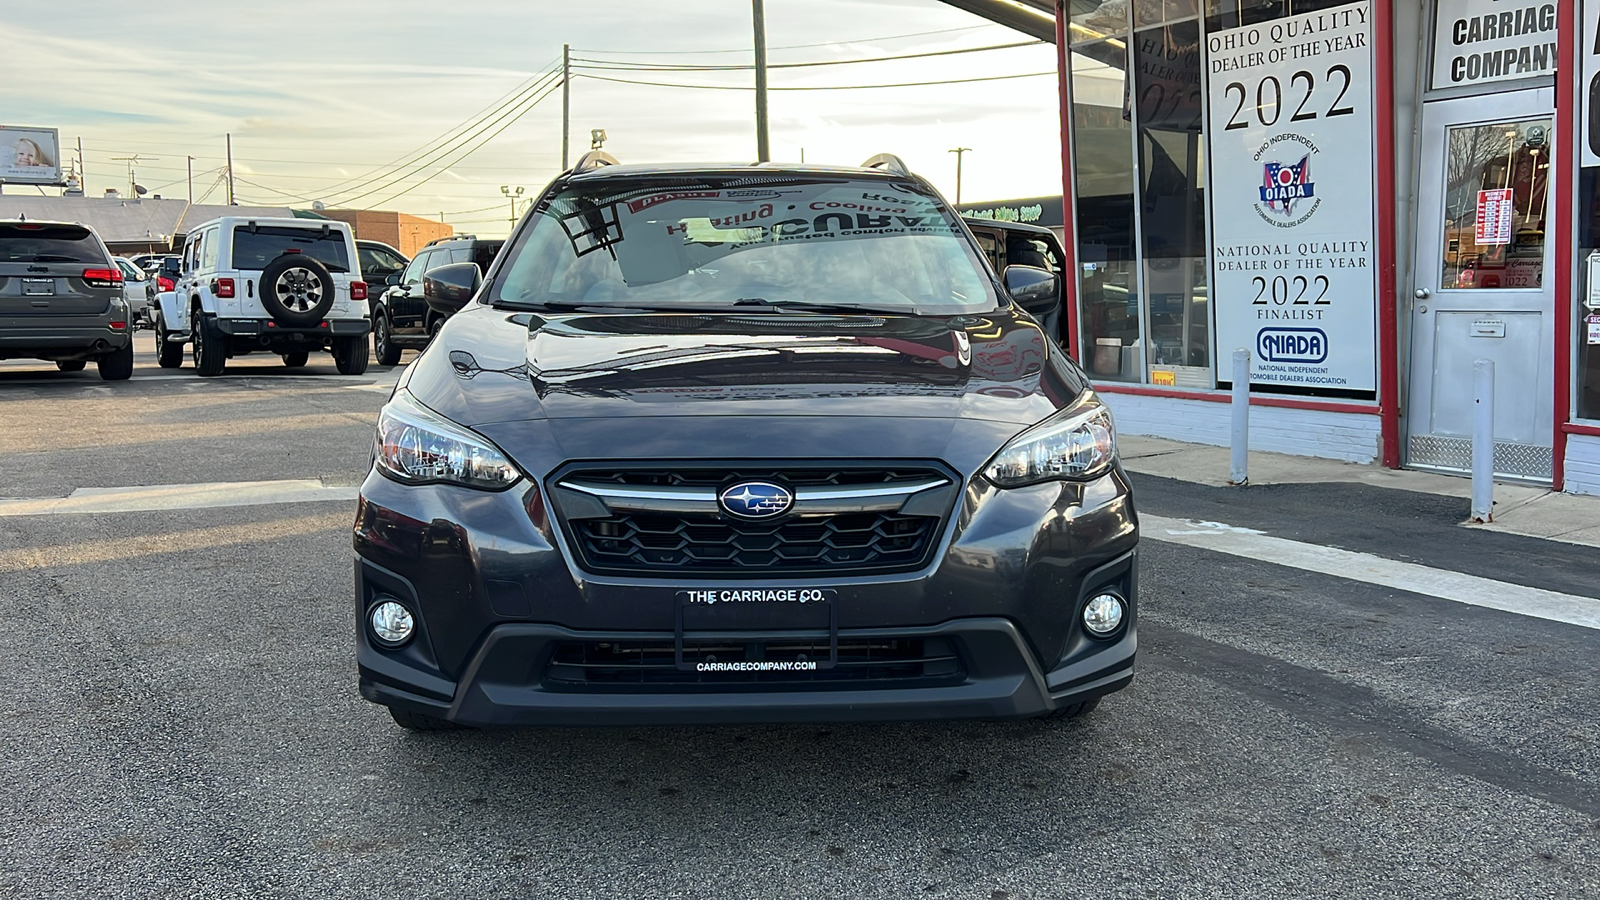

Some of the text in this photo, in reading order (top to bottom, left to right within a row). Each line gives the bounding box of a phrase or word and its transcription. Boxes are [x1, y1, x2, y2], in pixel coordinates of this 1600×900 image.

[1209, 6, 1369, 53] OHIO QUALITY
[1452, 4, 1559, 46] CARRIAG
[1212, 52, 1265, 73] DEALER
[1268, 47, 1287, 63] OF
[1290, 41, 1321, 59] THE
[1324, 32, 1366, 53] YEAR
[1224, 63, 1354, 131] 2022
[1253, 133, 1320, 161] OHIO INDEPENDENT
[1266, 185, 1305, 200] OIADA
[1253, 203, 1276, 227] AUTOMOBILE
[1297, 198, 1321, 225] ASSOCIATION
[1217, 241, 1369, 257] NATIONAL QUALITY
[1218, 257, 1367, 271] DEALER OF THE YEAR
[1251, 275, 1331, 305] 2022
[1257, 309, 1324, 320] FINALIST
[1262, 335, 1321, 355] NIADA
[1288, 366, 1328, 374] INDEPENDENT
[1280, 374, 1304, 382] DEALERS
[1305, 376, 1347, 385] ASSOCIATION
[687, 589, 825, 603] THE CARRIAGE CO.
[696, 661, 817, 671] CARRIAGECOMPANY.COM
